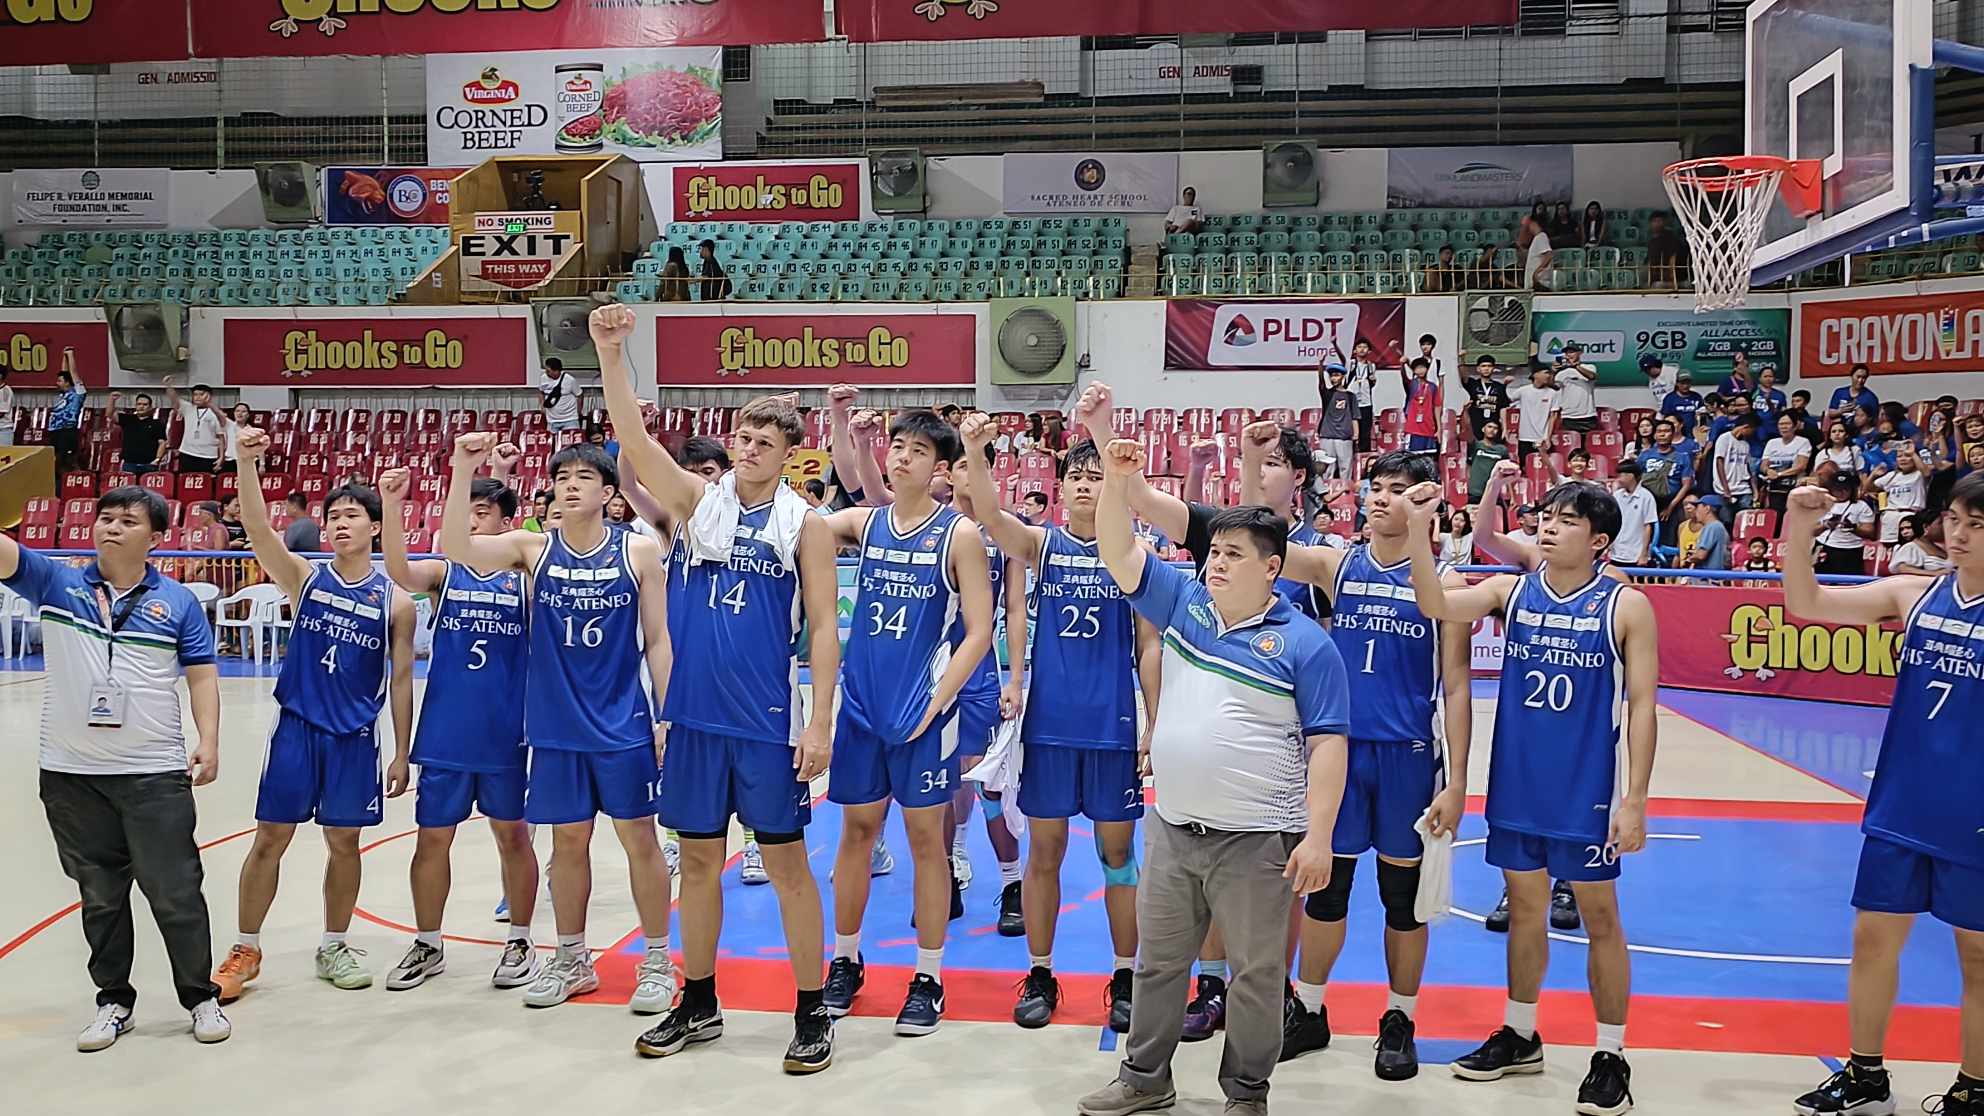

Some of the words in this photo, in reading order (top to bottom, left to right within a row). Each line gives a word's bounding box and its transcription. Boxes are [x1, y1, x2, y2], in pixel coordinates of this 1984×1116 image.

[167, 71, 217, 84] ADMISSIO
[1193, 65, 1232, 77] ADMIS
[464, 86, 516, 100] VIRGINIA
[557, 91, 600, 104] CORNED
[436, 104, 549, 129] CORNED
[566, 103, 593, 113] BEEF
[462, 130, 523, 150] BEEF
[27, 192, 57, 201] FELIPE
[107, 192, 154, 201] MEMORIAL
[688, 176, 786, 212] Chooks
[791, 187, 807, 205] to
[809, 175, 842, 208] Go
[478, 218, 494, 227] NO
[497, 216, 552, 227] SMOKING
[462, 235, 570, 256] EXIT
[485, 264, 516, 274] THIS
[518, 263, 547, 273] WAY
[1264, 318, 1343, 342] PLDT
[1636, 331, 1687, 350] 9GB
[1700, 329, 1720, 337] ALL
[11, 334, 47, 371] Go
[284, 330, 398, 371] Chooks
[403, 343, 422, 364] to
[425, 329, 463, 368] Go
[720, 327, 839, 369] Chooks
[845, 341, 866, 363] to
[869, 327, 909, 367] Go
[1298, 346, 1336, 357] Home
[1708, 342, 1731, 351] 7GB
[1751, 341, 1774, 350] 2GB
[708, 574, 746, 614] 14
[869, 601, 908, 640] 34
[1059, 604, 1101, 638] 25
[563, 616, 604, 648] 16
[320, 645, 337, 674] 4
[468, 639, 488, 669] 5
[1361, 639, 1376, 673] 1
[1524, 670, 1573, 711] 20
[1926, 680, 1952, 720] 7
[920, 768, 949, 789] 34
[366, 795, 379, 815] 4
[1584, 845, 1616, 868] 20
